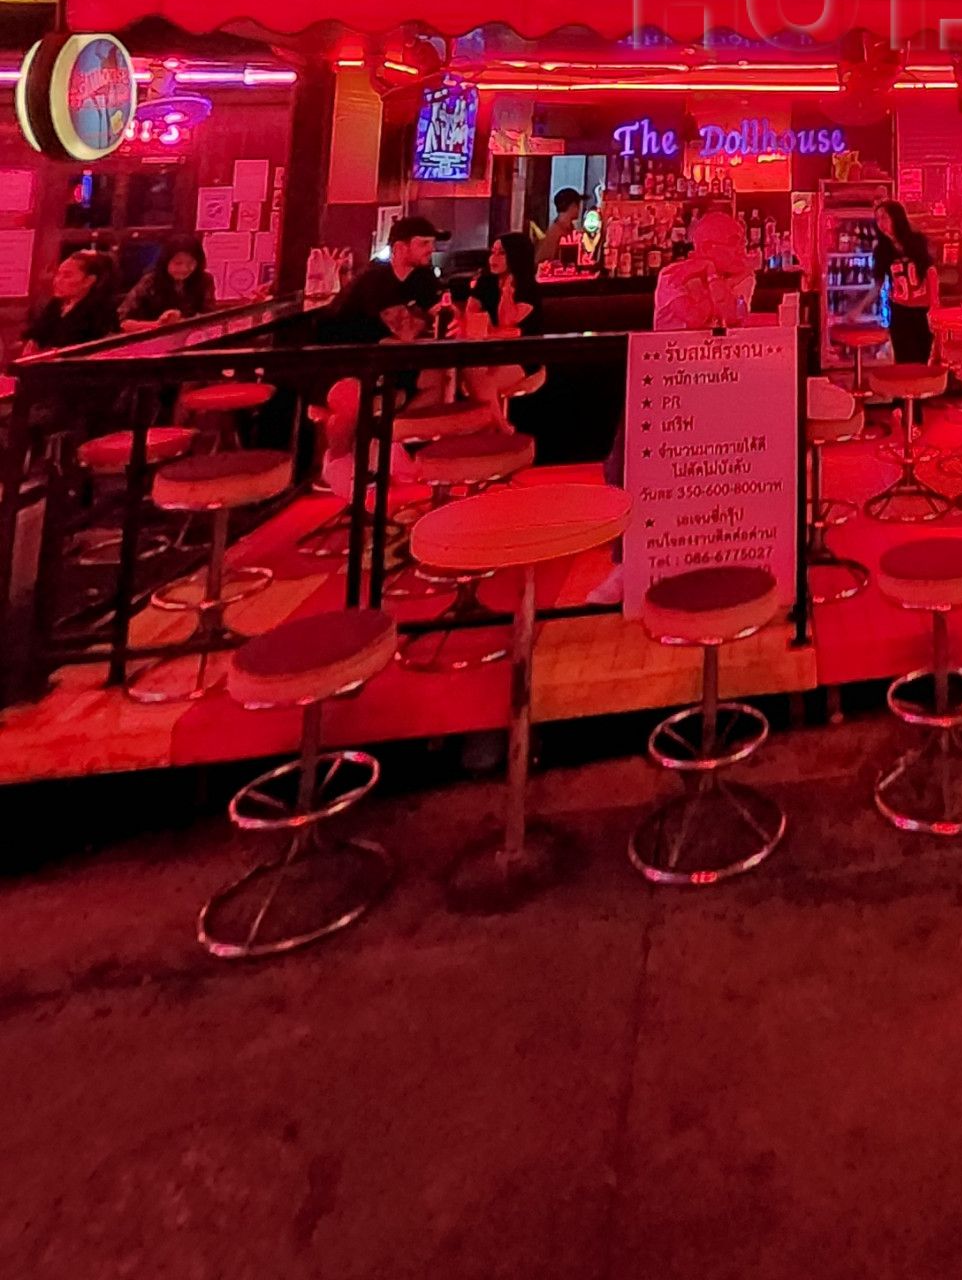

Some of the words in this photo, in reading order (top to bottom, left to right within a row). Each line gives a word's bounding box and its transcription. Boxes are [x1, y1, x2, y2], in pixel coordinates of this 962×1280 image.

[614, 119, 678, 156] The
[700, 119, 845, 157] Dollhouse
[665, 339, 763, 363] รับสมัครงาน
[662, 396, 681, 409] PR
[649, 555, 670, 568] Tel
